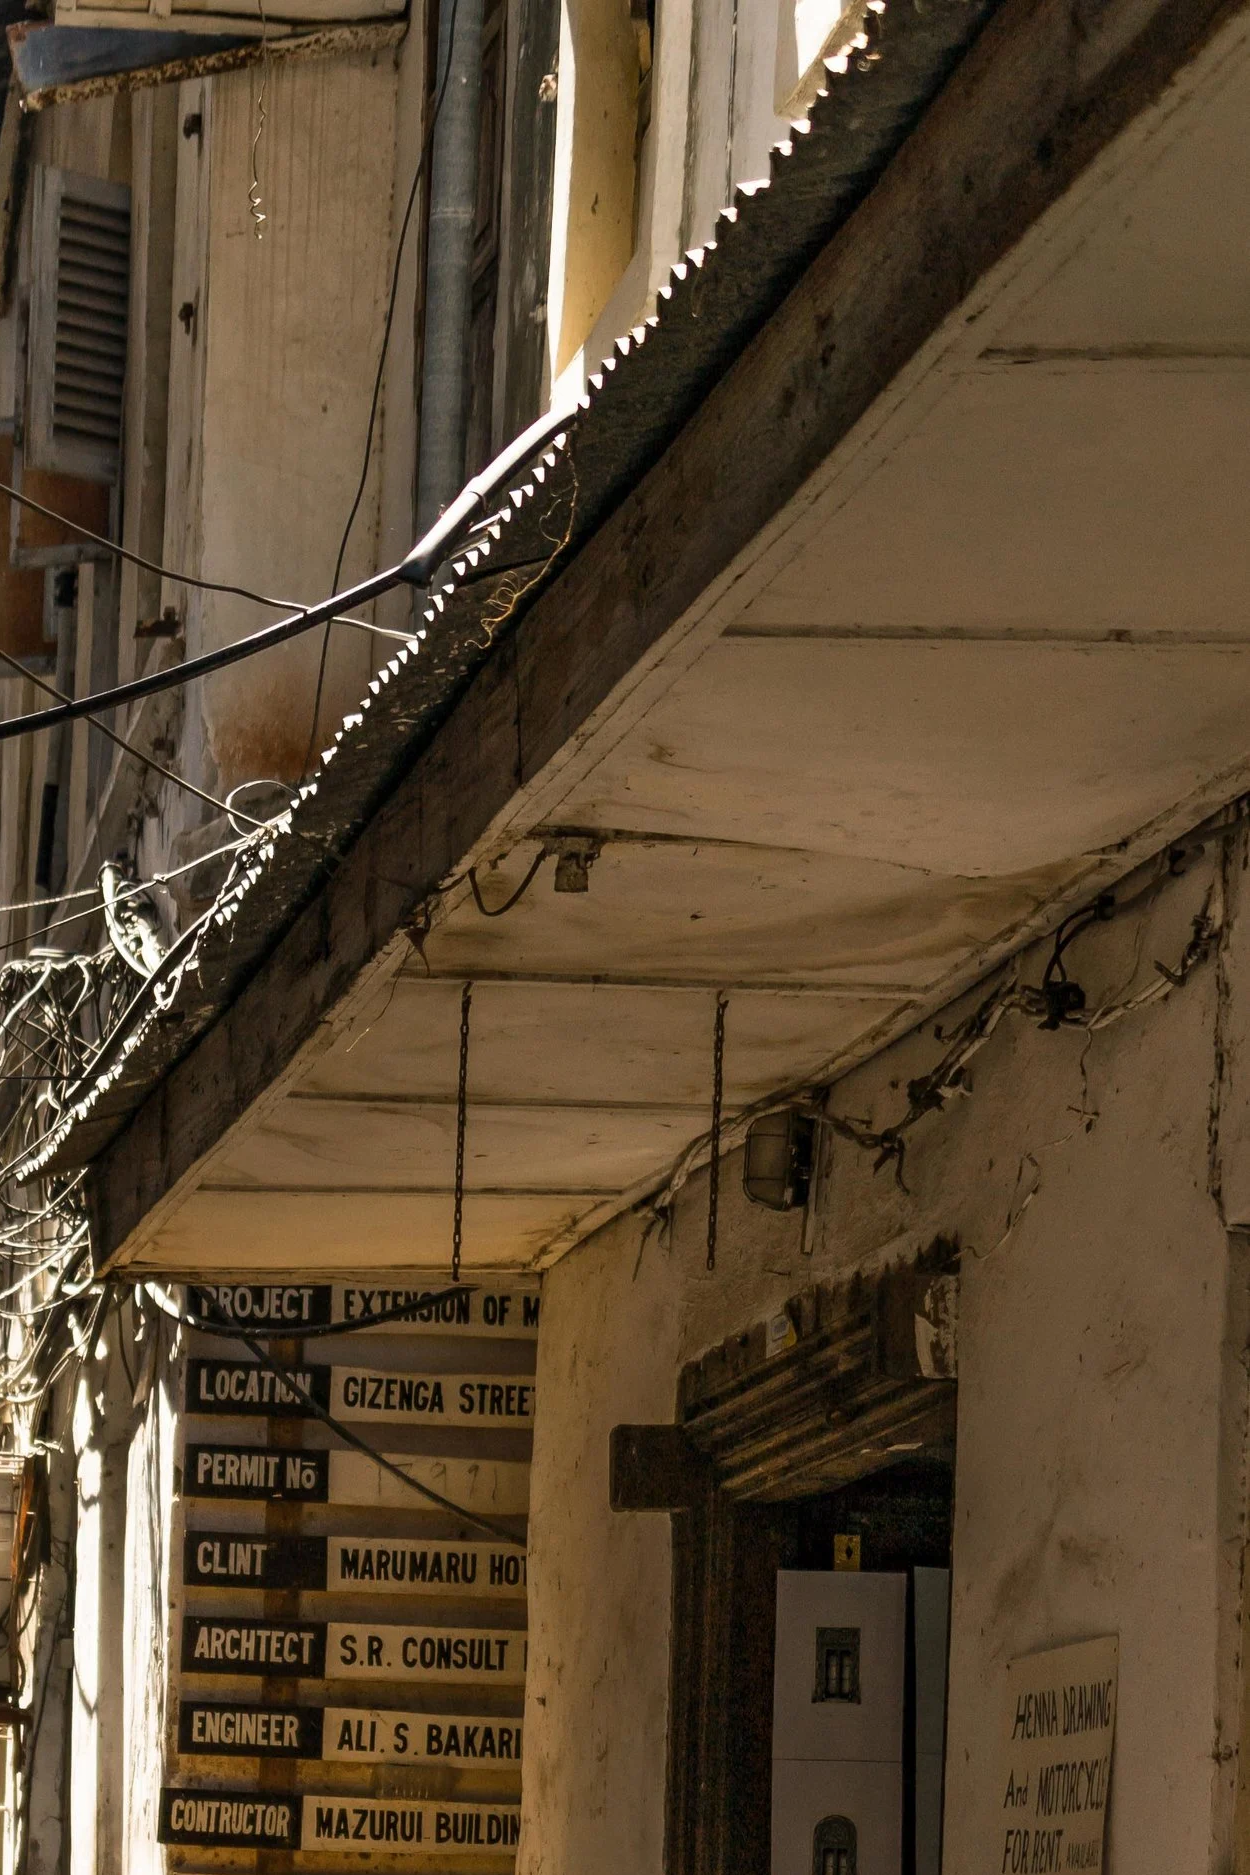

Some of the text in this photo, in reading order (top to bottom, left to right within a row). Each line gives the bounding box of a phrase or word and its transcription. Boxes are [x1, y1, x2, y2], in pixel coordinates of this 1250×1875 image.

[201, 1286, 313, 1320] PROJECT
[344, 1290, 470, 1324] EXTENSION
[483, 1295, 511, 1326] OF
[200, 1368, 311, 1403] LOCATION
[344, 1376, 536, 1416] GIZENGA STREE
[197, 1452, 279, 1488] PERMIT
[197, 1541, 267, 1576] CLINT
[340, 1548, 477, 1584] MARUMARU
[340, 1635, 392, 1668] S.R.
[402, 1637, 508, 1671] CONSULT
[1011, 1679, 1112, 1740] HENNA DRAWING
[192, 1711, 299, 1747] ENGINEER
[337, 1719, 385, 1753] ALI.
[426, 1724, 521, 1759] BAKARI
[170, 1799, 291, 1837] CONTRUCTOR
[316, 1806, 423, 1843] MAZURUI
[1001, 1829, 1030, 1874] FOR
